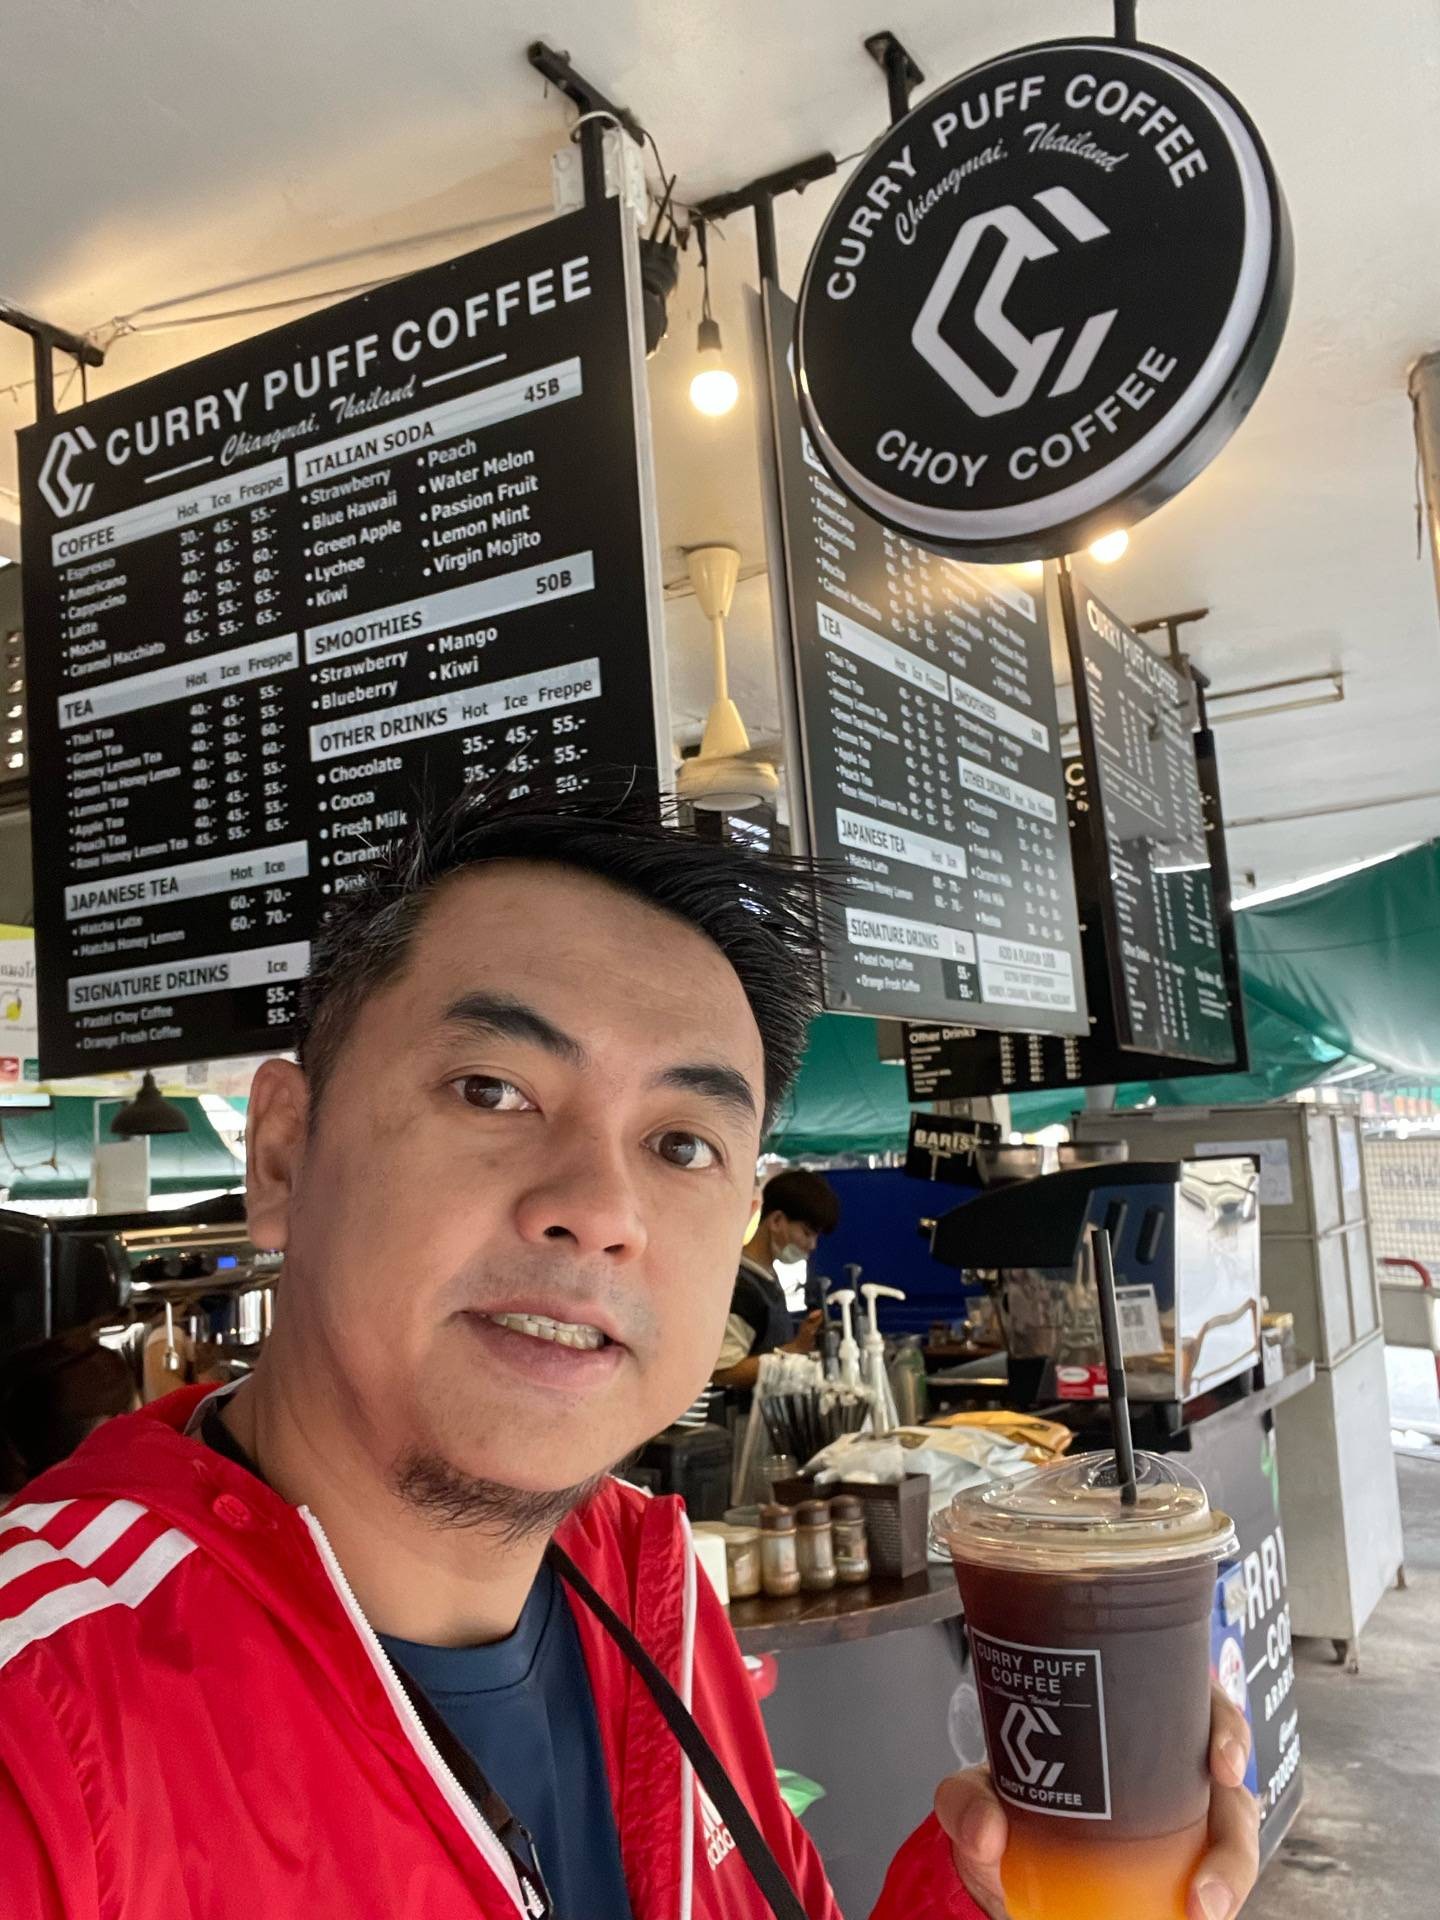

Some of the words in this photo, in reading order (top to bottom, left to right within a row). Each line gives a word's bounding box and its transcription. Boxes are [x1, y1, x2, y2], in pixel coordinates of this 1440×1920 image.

[1023, 122, 1129, 172] Thailand
[826, 144, 919, 301] CURRY
[931, 75, 1045, 150] PUFF
[1064, 74, 1209, 190] COFFEE
[106, 381, 248, 466] CURRY
[264, 333, 379, 411] PUFF
[392, 256, 592, 361] COFFEE
[330, 374, 416, 424] Thailand
[875, 429, 989, 487] CHOY
[1008, 346, 1178, 481] COFFEE
[305, 440, 378, 478] ITALIAN
[384, 421, 435, 450] SODA
[524, 378, 560, 402] 45B
[311, 469, 391, 504] Strawberry
[428, 438, 476, 467] Peach
[429, 467, 478, 493] Water
[483, 450, 534, 476] Melon
[58, 527, 115, 558] COFFEE
[177, 502, 198, 520] Hot
[212, 494, 231, 508] Ice
[240, 476, 283, 499] Freppe
[312, 509, 344, 531] Blue
[347, 490, 397, 519] Hawaii
[431, 490, 493, 521] Passion
[498, 475, 538, 502] Fruit
[313, 534, 356, 557] Green
[360, 519, 401, 547] Apple
[433, 520, 487, 547] Lemon
[492, 505, 530, 529] Mint
[315, 555, 365, 584] Lychee
[434, 547, 483, 574] Virgin
[487, 531, 541, 558] Mojito
[315, 611, 422, 655] SMOOTHIES
[535, 570, 572, 594] 50B
[316, 585, 348, 607] Kiwi
[822, 613, 841, 639] TEA
[319, 651, 408, 684] Strawberry
[439, 626, 498, 654] Mango
[65, 700, 93, 720] TEA
[186, 672, 207, 688] Hot
[220, 664, 240, 680] Ice
[249, 651, 293, 672] Freppe
[321, 680, 398, 710] Blueberry
[440, 656, 479, 681] Kiwi
[320, 725, 375, 753] OTHER
[380, 708, 448, 738] DRINKS
[462, 702, 489, 720] Hot
[504, 694, 528, 711] Ice
[539, 677, 592, 703] Freppe
[329, 757, 402, 784] Chocolate
[330, 790, 375, 811] Cocoa
[332, 817, 373, 840] Fresh
[376, 810, 408, 831] Milk
[841, 819, 889, 849] JAPANESE
[890, 833, 906, 854] TEA
[70, 882, 145, 912] JAPANESE
[150, 877, 179, 897] TEA
[230, 865, 253, 881] Hot
[264, 860, 285, 874] Ice
[851, 918, 904, 944] SIGNATURE
[906, 928, 939, 950] DRINKS
[74, 974, 161, 1004] SIGNATURE
[166, 964, 229, 990] DRINKS
[267, 960, 288, 974] Ice
[976, 1642, 1023, 1671] CURRY
[1033, 1658, 1086, 1678] PUFF
[991, 1665, 1061, 1694] COFFEE
[1029, 1787, 1083, 1806] COFFEE
